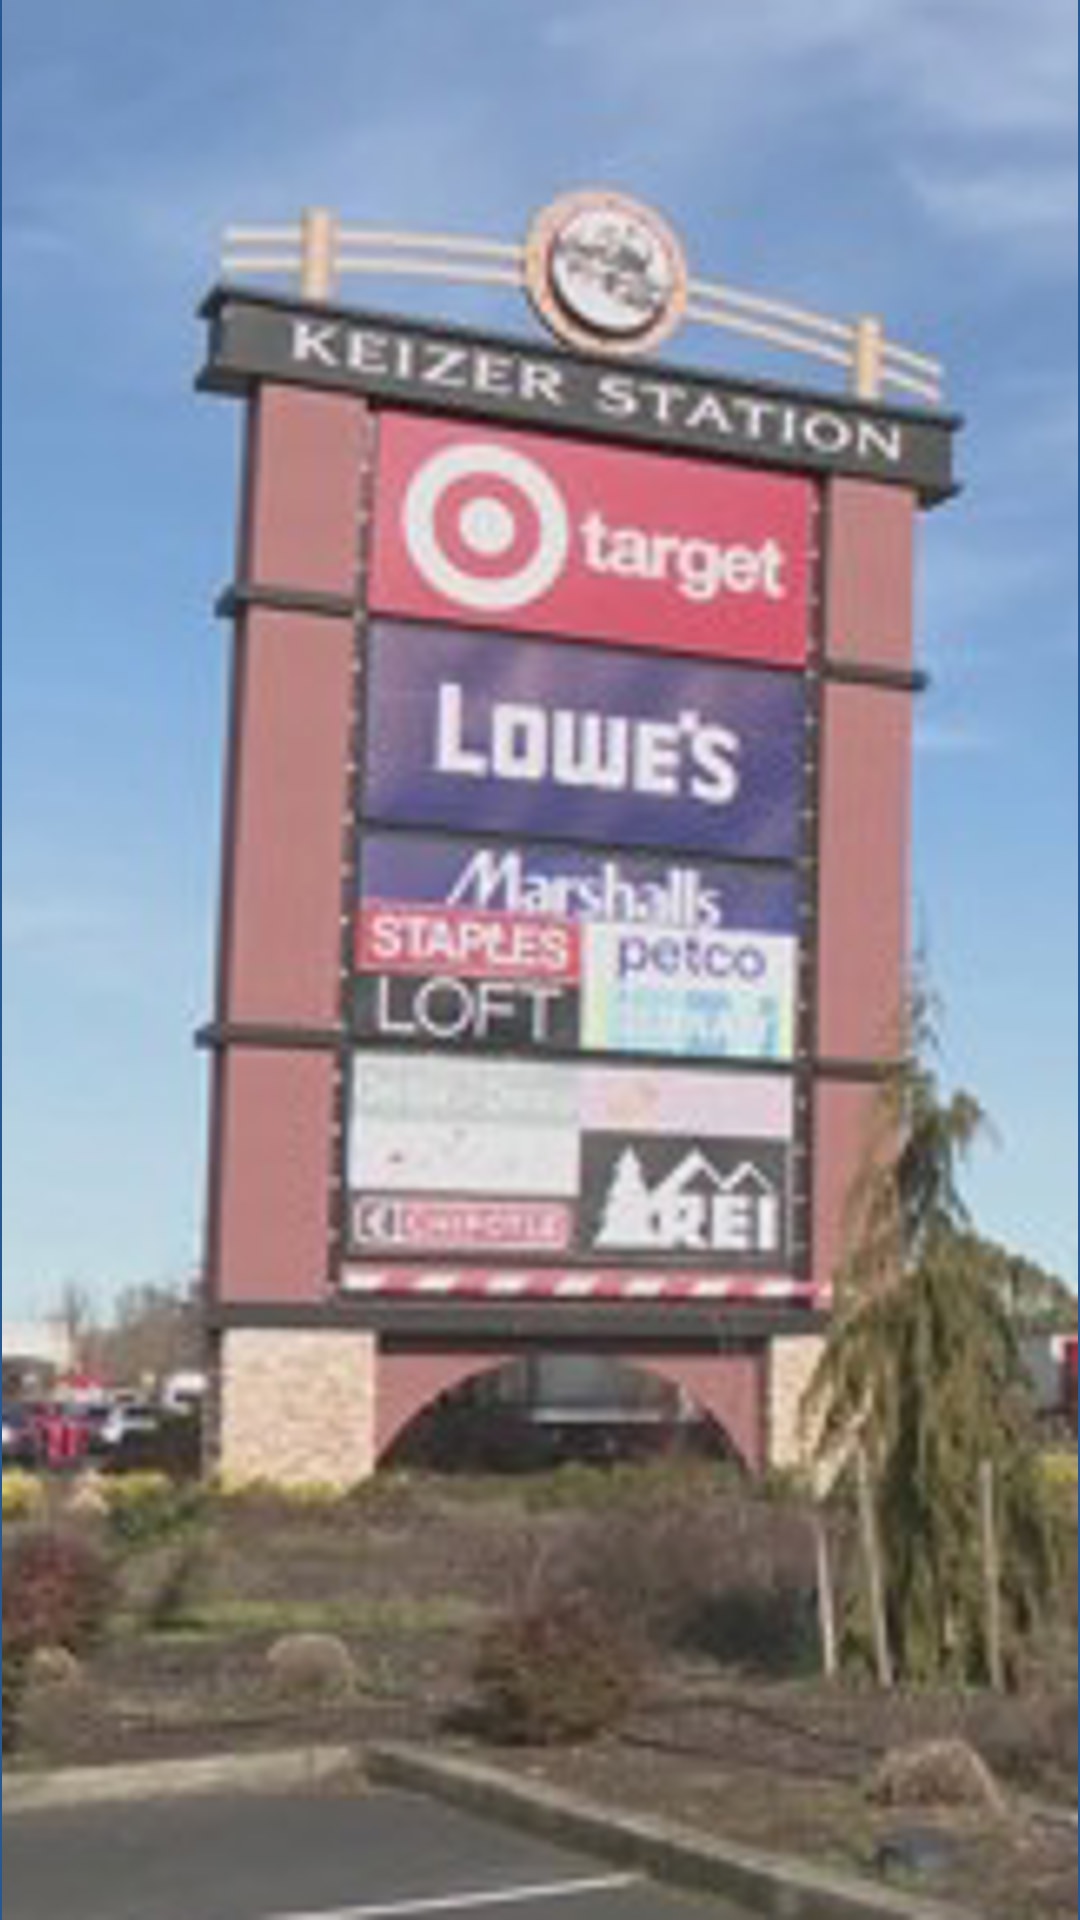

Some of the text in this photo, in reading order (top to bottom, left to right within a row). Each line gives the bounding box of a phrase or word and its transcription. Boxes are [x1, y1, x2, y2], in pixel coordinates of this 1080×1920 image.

[291, 320, 903, 462] KEIZER STATION
[579, 512, 785, 599] target
[435, 683, 741, 804] LOWE'S
[446, 849, 722, 929] Marshalls
[372, 912, 568, 971] STAPLES
[618, 934, 767, 979] petco
[378, 974, 561, 1041] LOFT
[659, 1193, 780, 1250] REI
